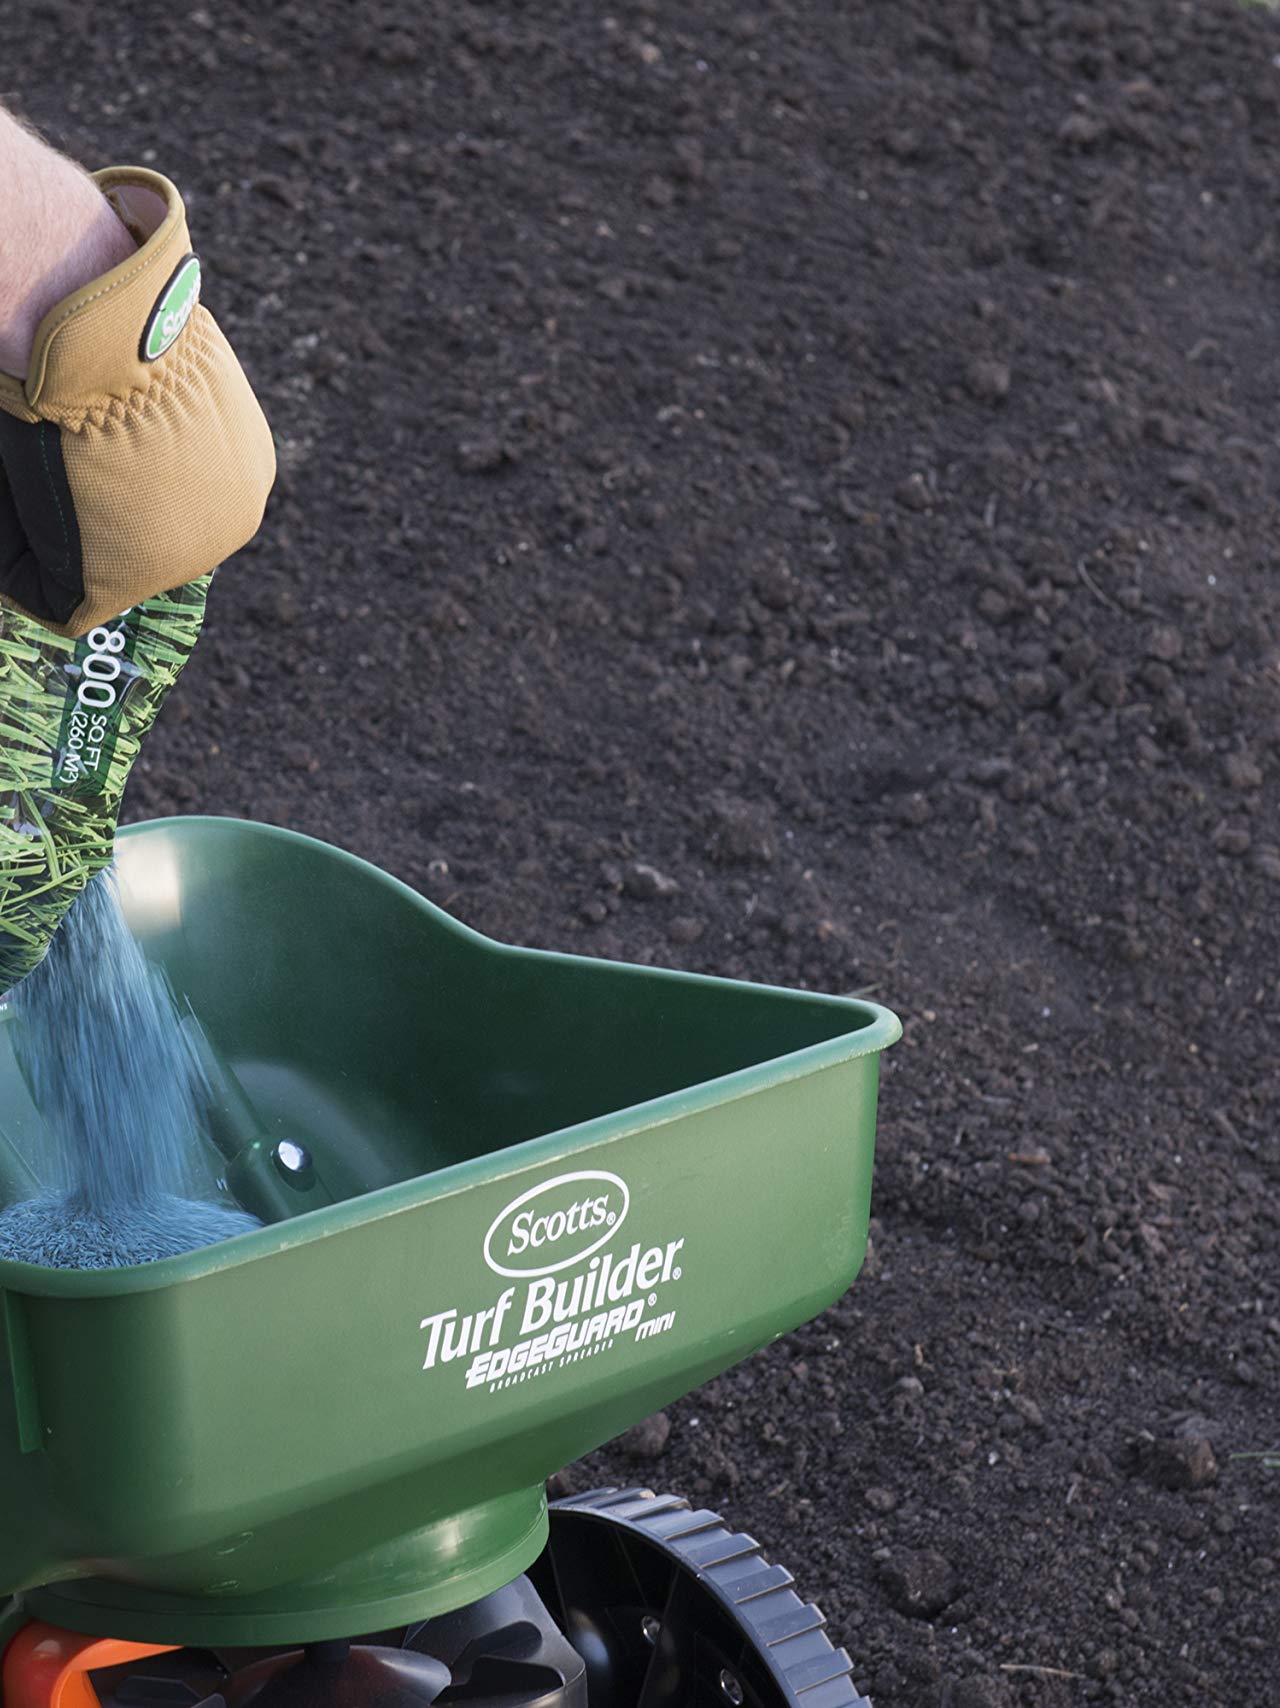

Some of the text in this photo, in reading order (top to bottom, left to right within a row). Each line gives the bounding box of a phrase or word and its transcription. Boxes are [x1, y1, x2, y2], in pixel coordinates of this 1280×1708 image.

[75, 607, 131, 770] 800 SQ FT
[67, 710, 87, 749] (260
[508, 1193, 608, 1256] Scotts
[420, 1237, 684, 1370] Turf Builder
[635, 1310, 675, 1341] mini
[490, 1338, 613, 1393] BROADCAST SPREADER
